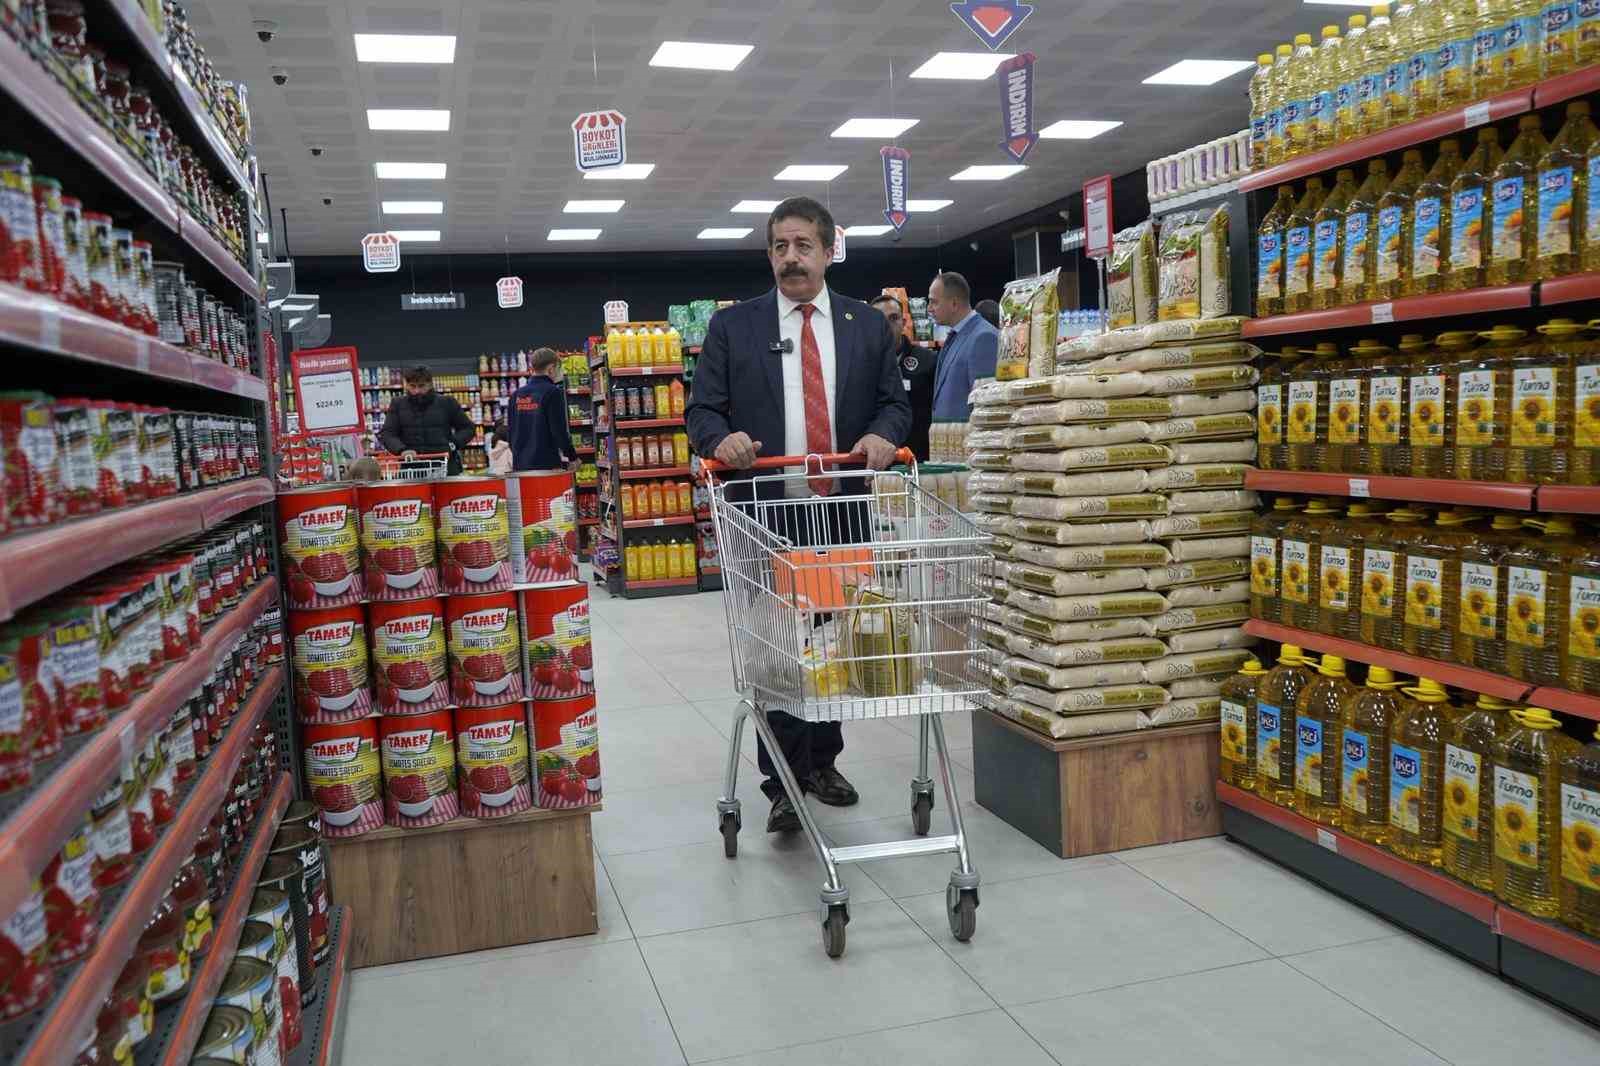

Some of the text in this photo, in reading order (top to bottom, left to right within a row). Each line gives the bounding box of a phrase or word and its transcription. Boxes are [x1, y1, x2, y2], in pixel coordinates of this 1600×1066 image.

[582, 129, 616, 142] BOYKOT
[411, 296, 433, 304] bebek
[1375, 386, 1397, 396] Turna
[1414, 384, 1440, 396] Turna
[1463, 381, 1490, 393] Turna
[1518, 378, 1550, 391] Turna
[1292, 389, 1313, 399] Turna
[1335, 388, 1355, 398] Turna
[375, 503, 417, 519] TAMEK
[453, 499, 494, 513] TAMEK
[300, 509, 344, 526] TAMEK
[1285, 548, 1305, 559] Turna
[1324, 553, 1345, 566] Turna
[1367, 557, 1390, 570] Turna
[1411, 564, 1437, 579] Turna
[1466, 571, 1492, 586] Turna
[1513, 576, 1540, 592] Turna
[1576, 587, 1600, 600] Turn
[569, 604, 589, 618] TAM
[388, 619, 429, 634] TAMEK
[463, 613, 505, 627] TAMEK
[307, 626, 350, 641] TAMEK
[576, 712, 597, 728] TAM
[470, 724, 511, 740] TAMEK
[388, 734, 429, 748] TAMEK
[313, 742, 355, 757] TAMEK
[1448, 754, 1476, 774] Turna
[1499, 776, 1534, 799] Turna
